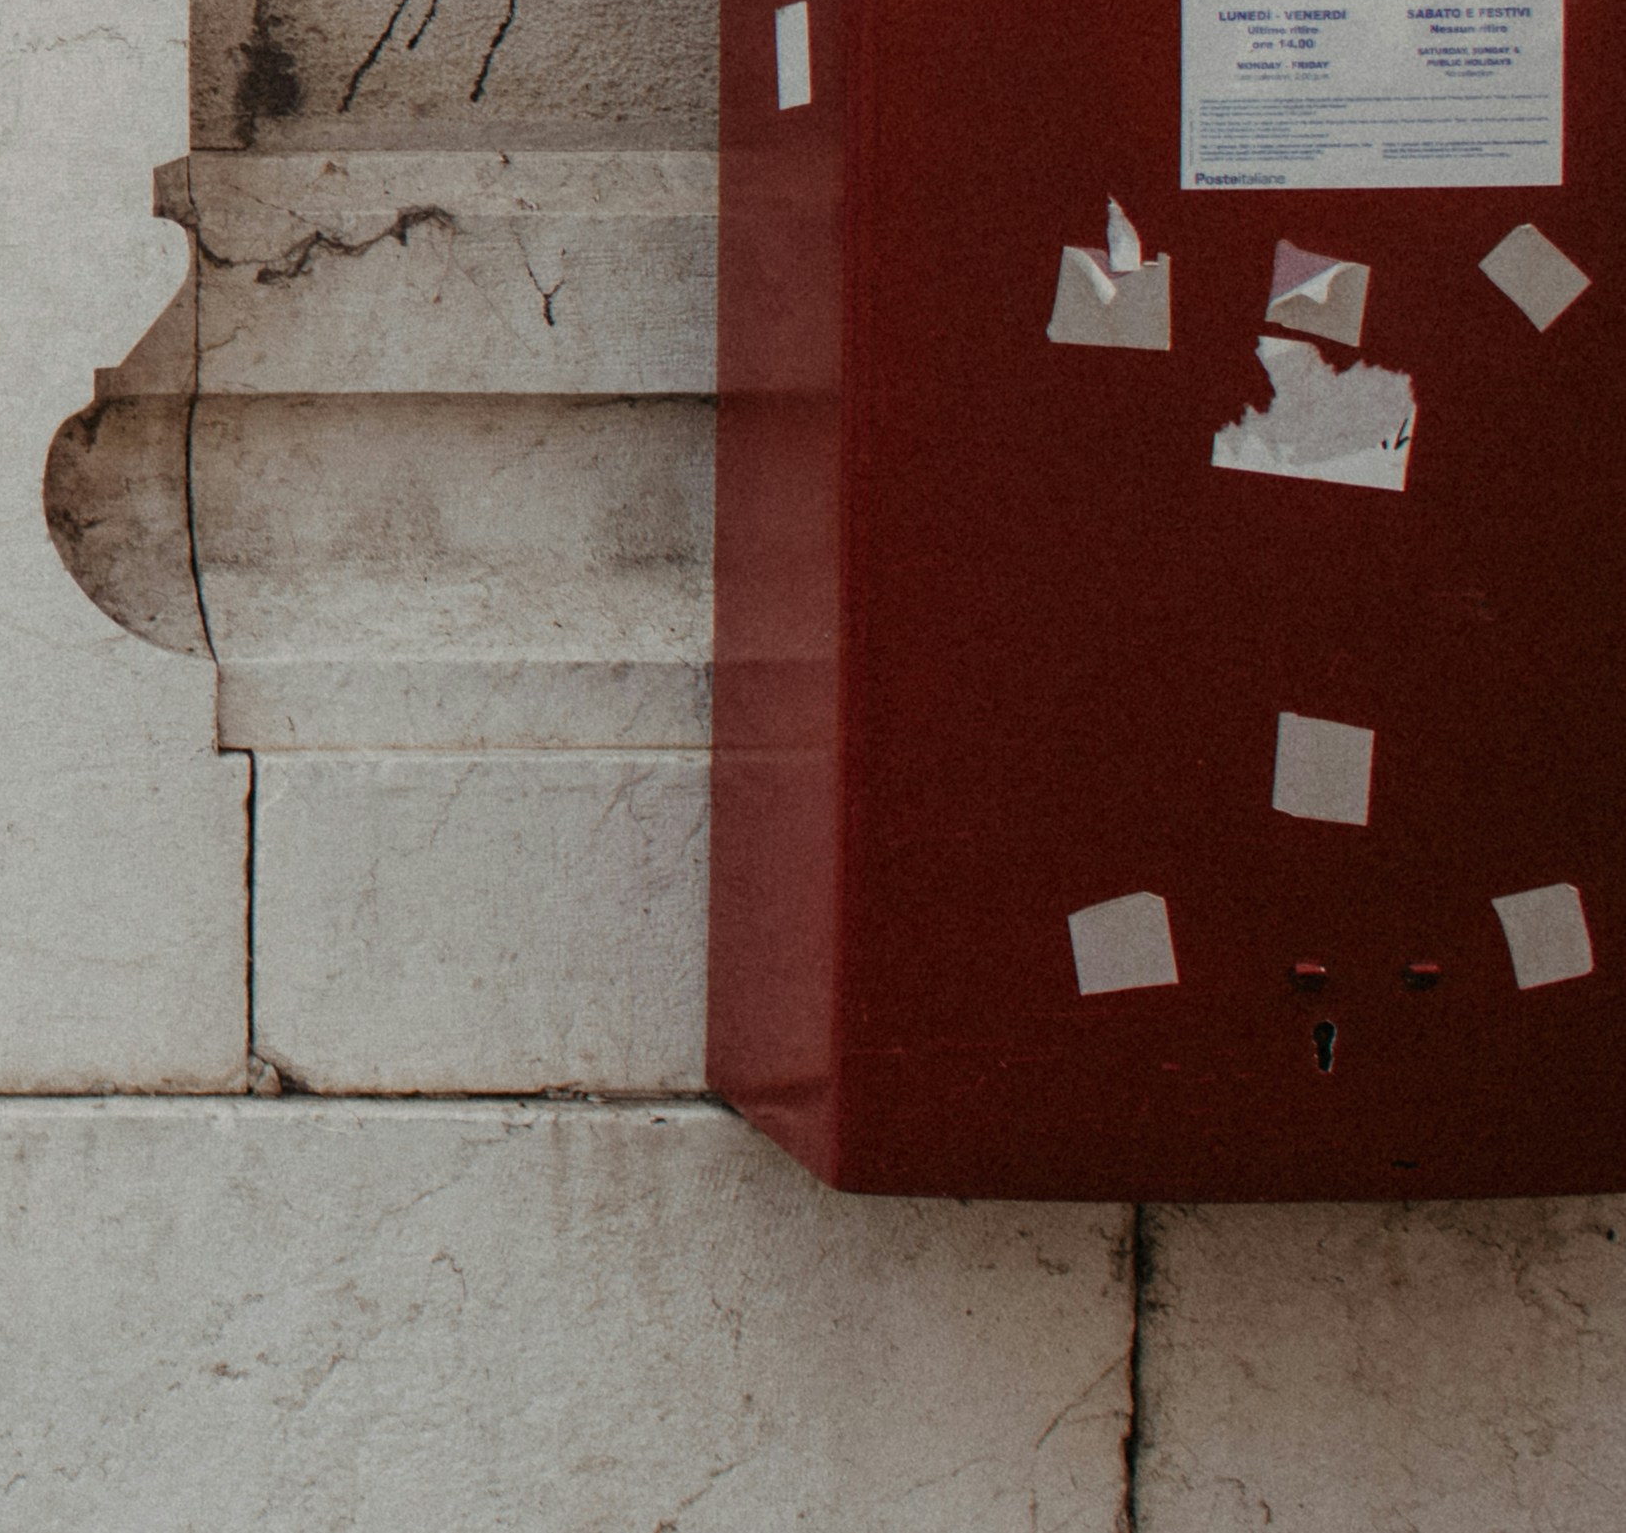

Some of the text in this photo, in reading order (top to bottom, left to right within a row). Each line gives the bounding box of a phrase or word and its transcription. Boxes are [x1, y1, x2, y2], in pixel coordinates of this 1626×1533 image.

[1406, 7, 1532, 19] SABATO E FESTIVI
[1248, 26, 1286, 35] Ultimo
[1430, 24, 1475, 33] Nessun
[1252, 39, 1314, 49] ore 14.00
[1472, 47, 1509, 55] SUNDAY
[1237, 61, 1282, 70] MONDAY
[1291, 61, 1329, 69] FRIDAY
[1426, 58, 1511, 67] PUBLIC HOLIDAYS
